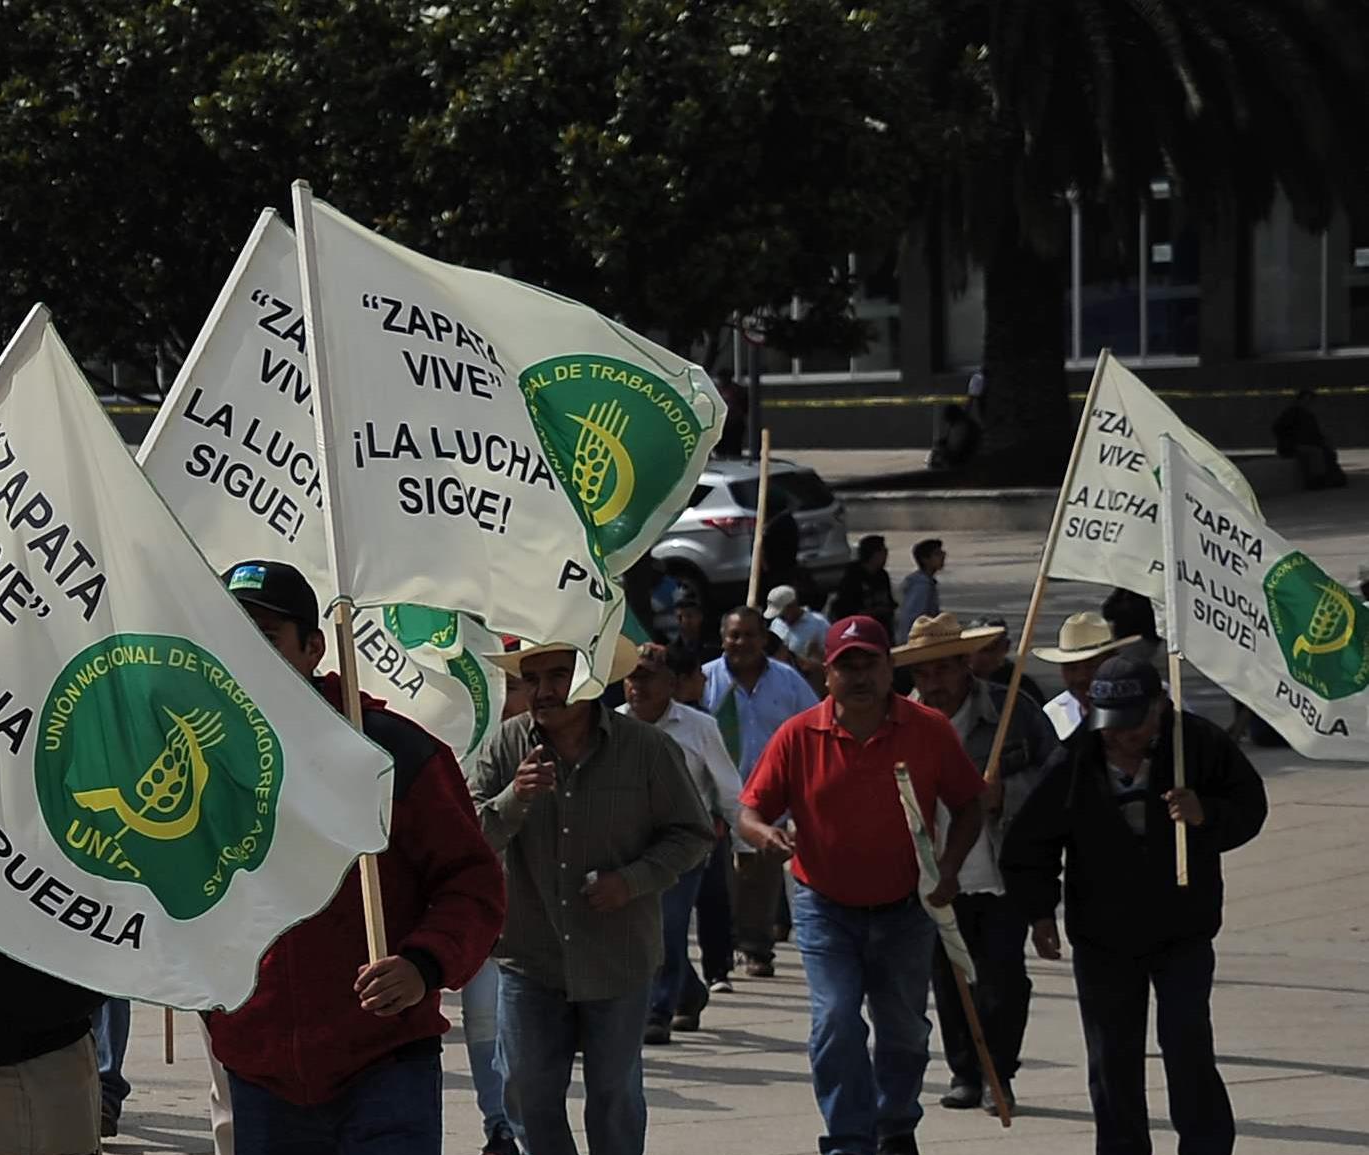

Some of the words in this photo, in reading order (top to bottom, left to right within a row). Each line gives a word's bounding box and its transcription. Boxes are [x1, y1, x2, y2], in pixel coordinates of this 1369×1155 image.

[402, 350, 501, 399] VIVE”
[554, 363, 583, 382] DE
[183, 388, 233, 438] LA
[242, 418, 324, 509] LUCH
[354, 422, 422, 468] ¡LA
[431, 427, 555, 491] LUCHA
[185, 443, 305, 543] SIGUE!
[1185, 493, 1263, 563] “ZAPATA
[1177, 560, 1206, 593] ¡LA
[1210, 579, 1271, 637] LUCHA
[1193, 598, 1257, 652] SIGUE!
[44, 683, 81, 752] UNIÓN
[76, 645, 162, 690] NACIONAL
[168, 648, 198, 673] DE
[201, 660, 275, 816] TRABAJADORES
[1275, 680, 1350, 737] PUEBLA
